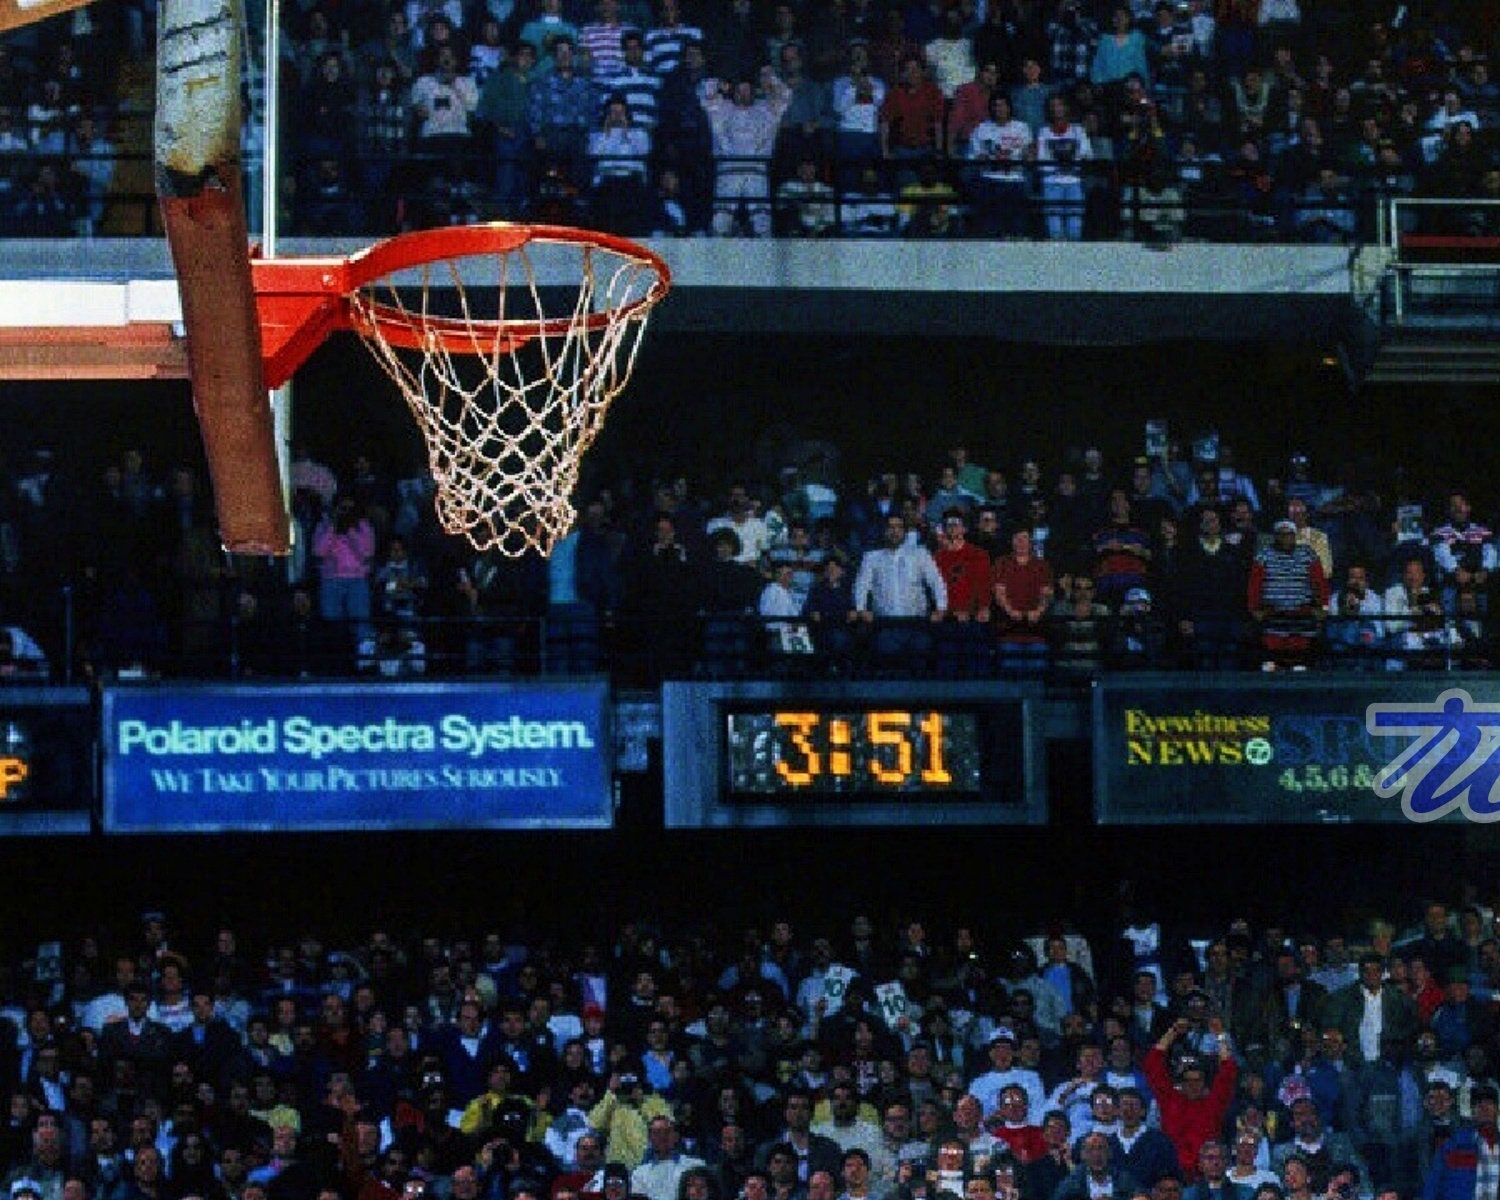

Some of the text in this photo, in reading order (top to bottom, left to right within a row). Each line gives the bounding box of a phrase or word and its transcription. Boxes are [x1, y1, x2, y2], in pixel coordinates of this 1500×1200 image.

[119, 714, 595, 760] Polaroid Spectra System.
[1124, 709, 1271, 734] Eyewitness
[775, 711, 952, 785] 3:51
[1127, 740, 1244, 765] NEWS
